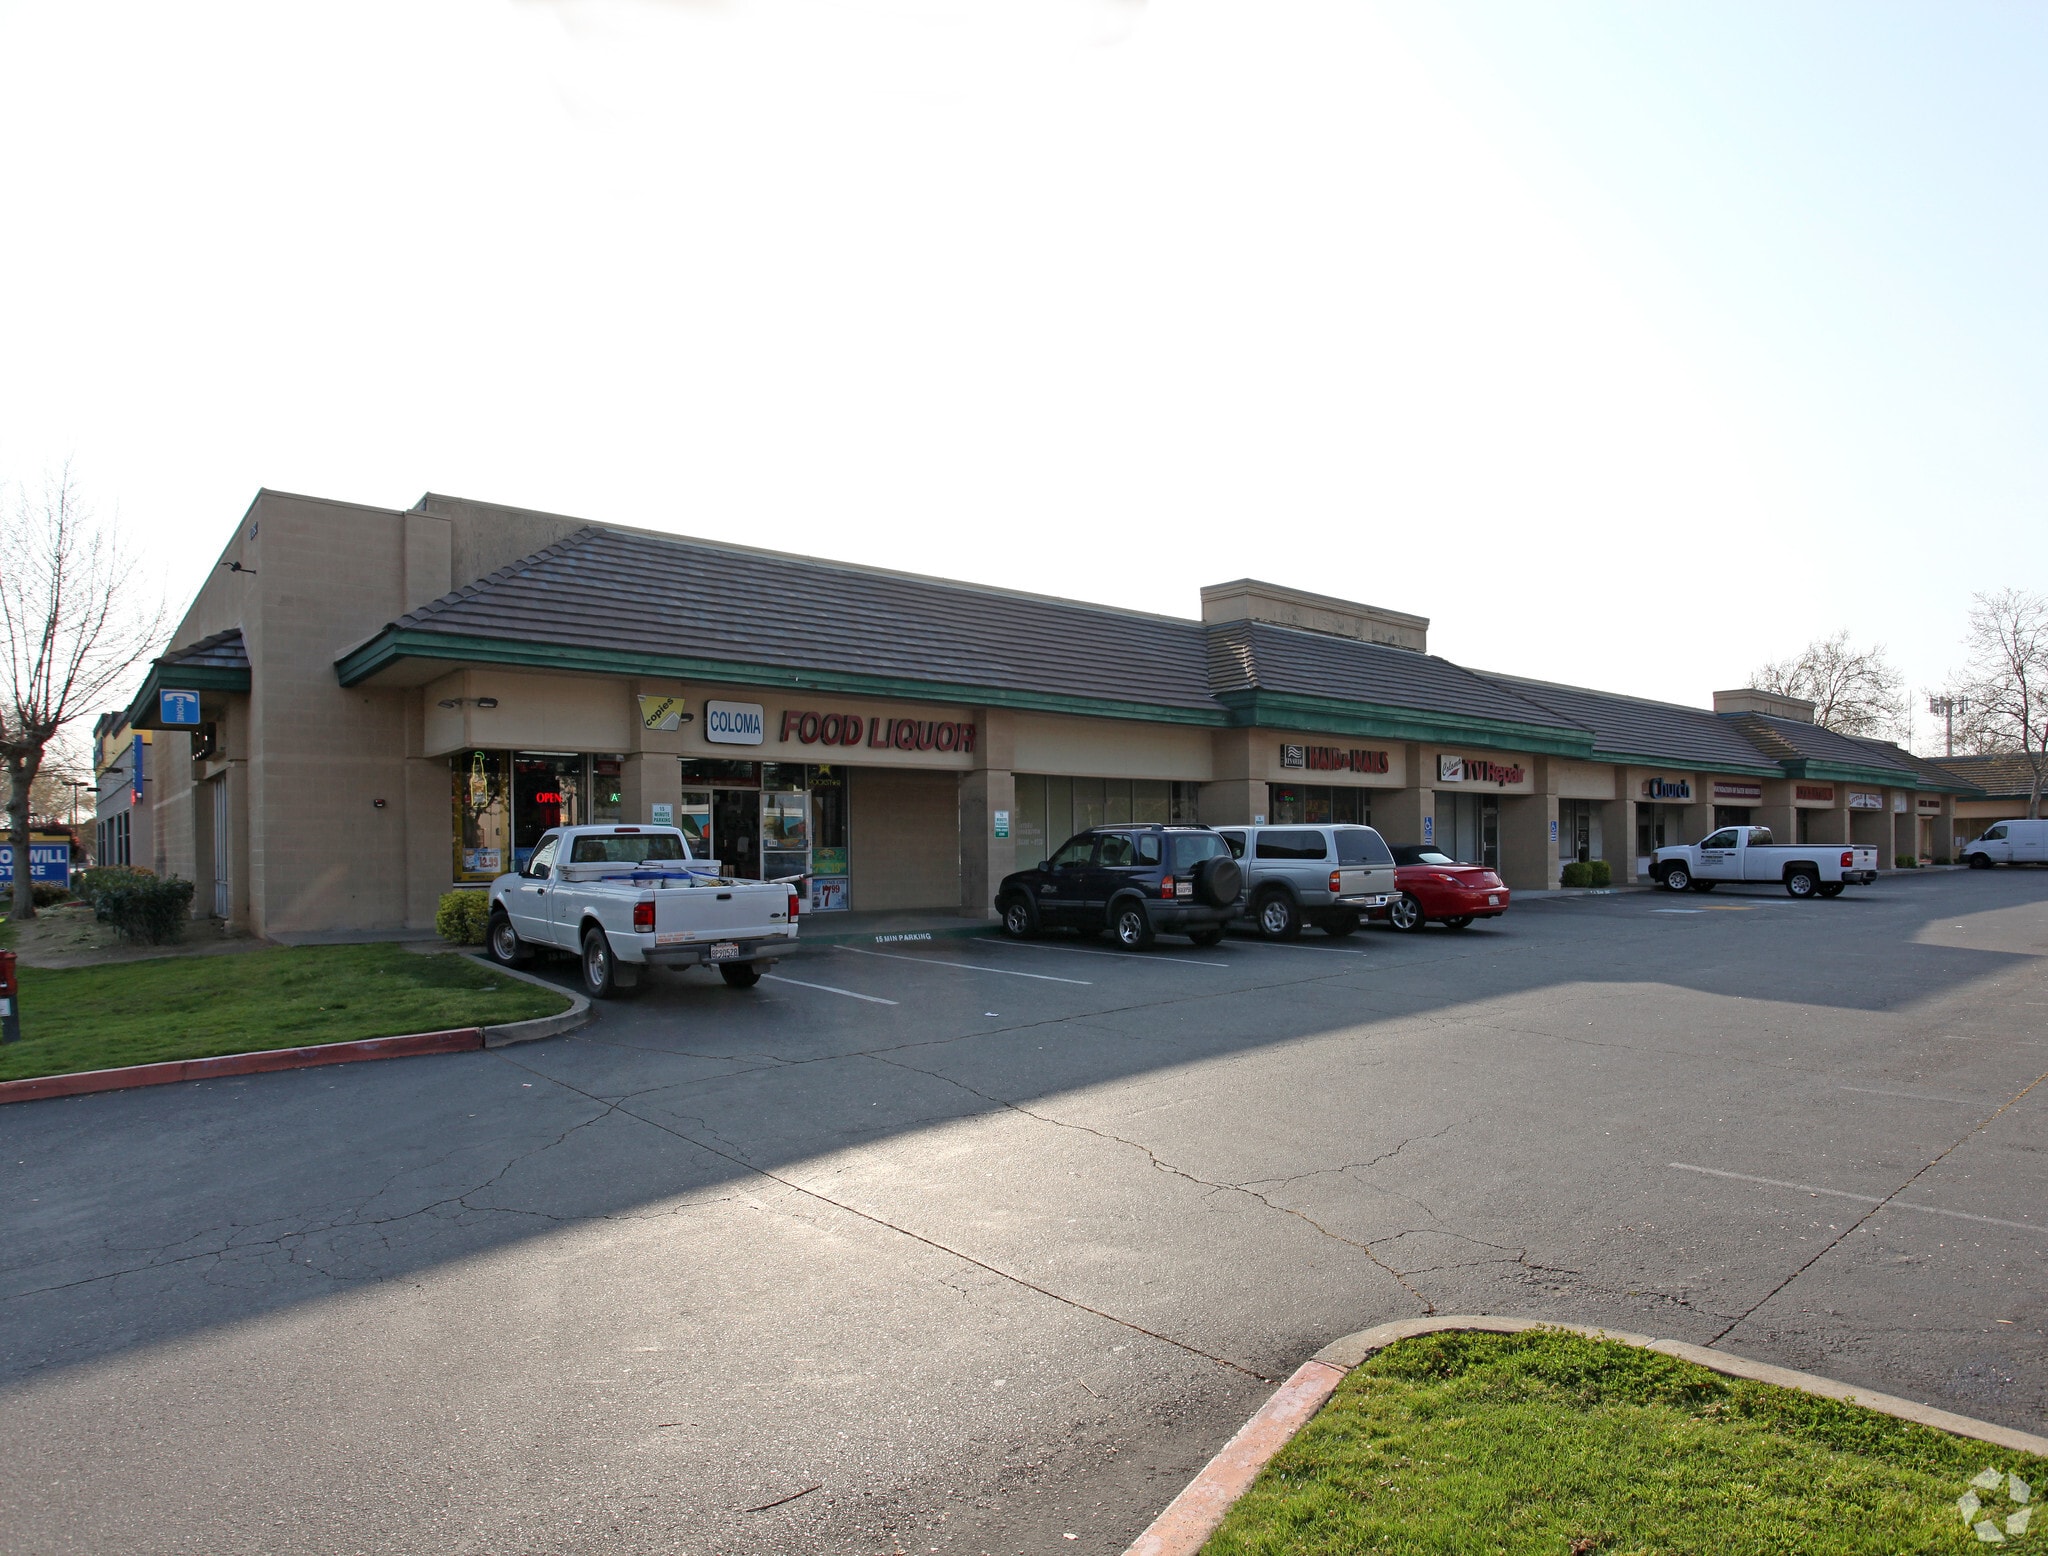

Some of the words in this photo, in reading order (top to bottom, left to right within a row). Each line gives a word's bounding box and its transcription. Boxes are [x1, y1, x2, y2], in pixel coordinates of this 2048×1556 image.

[176, 697, 184, 722] PHONE
[646, 698, 674, 726] copies
[710, 710, 761, 734] COLOMA
[780, 710, 864, 746] FOOD
[868, 717, 976, 752] LIQUOR
[1350, 750, 1389, 774] NAILS
[1488, 761, 1525, 787] Repair
[535, 792, 563, 803] OPEN
[1649, 778, 1690, 799] Church
[875, 935, 884, 943] 15
[884, 934, 898, 942] MIN
[899, 932, 932, 941] PARKING
